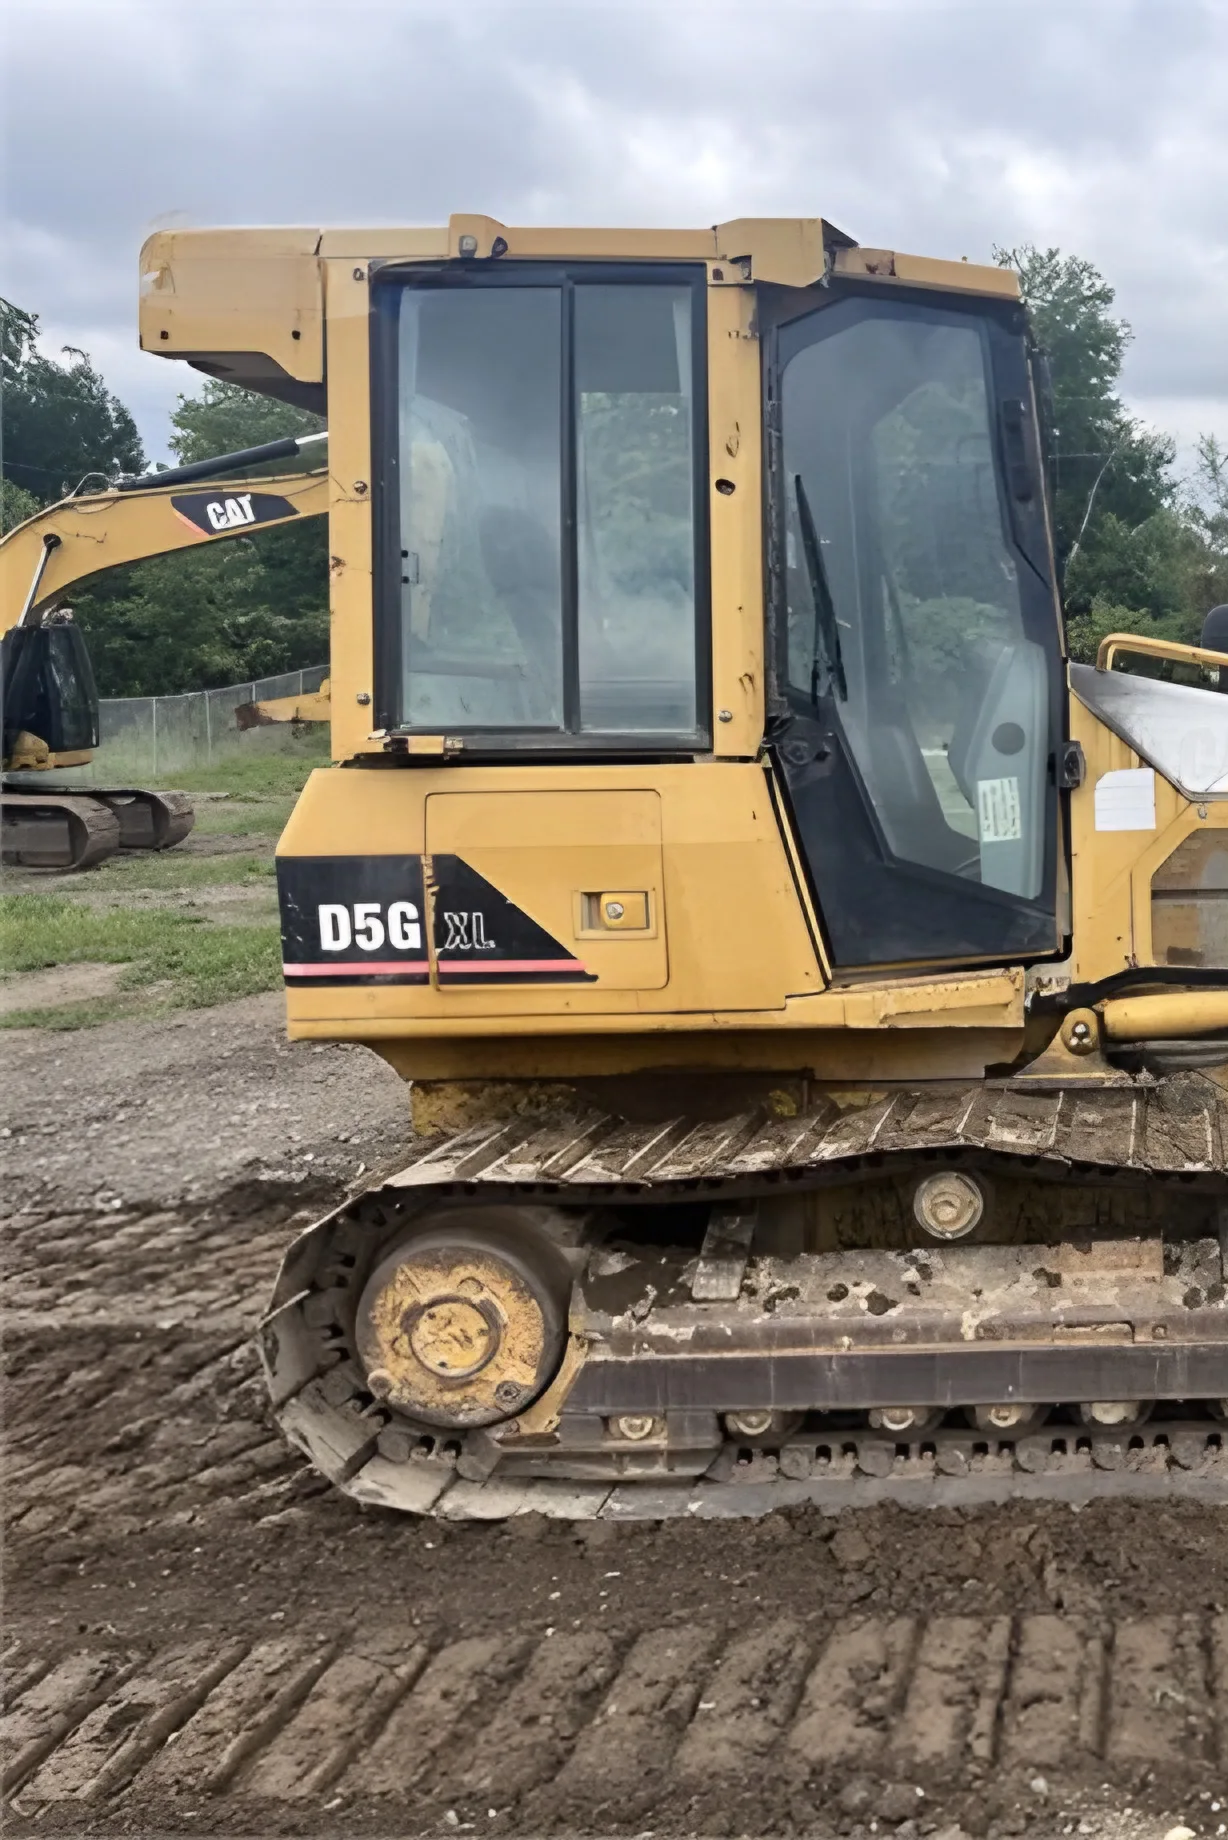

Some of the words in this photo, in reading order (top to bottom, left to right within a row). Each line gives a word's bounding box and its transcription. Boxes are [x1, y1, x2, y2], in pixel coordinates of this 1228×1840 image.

[206, 494, 256, 530] CAT
[318, 902, 422, 951] D5G
[444, 911, 497, 950] XL
